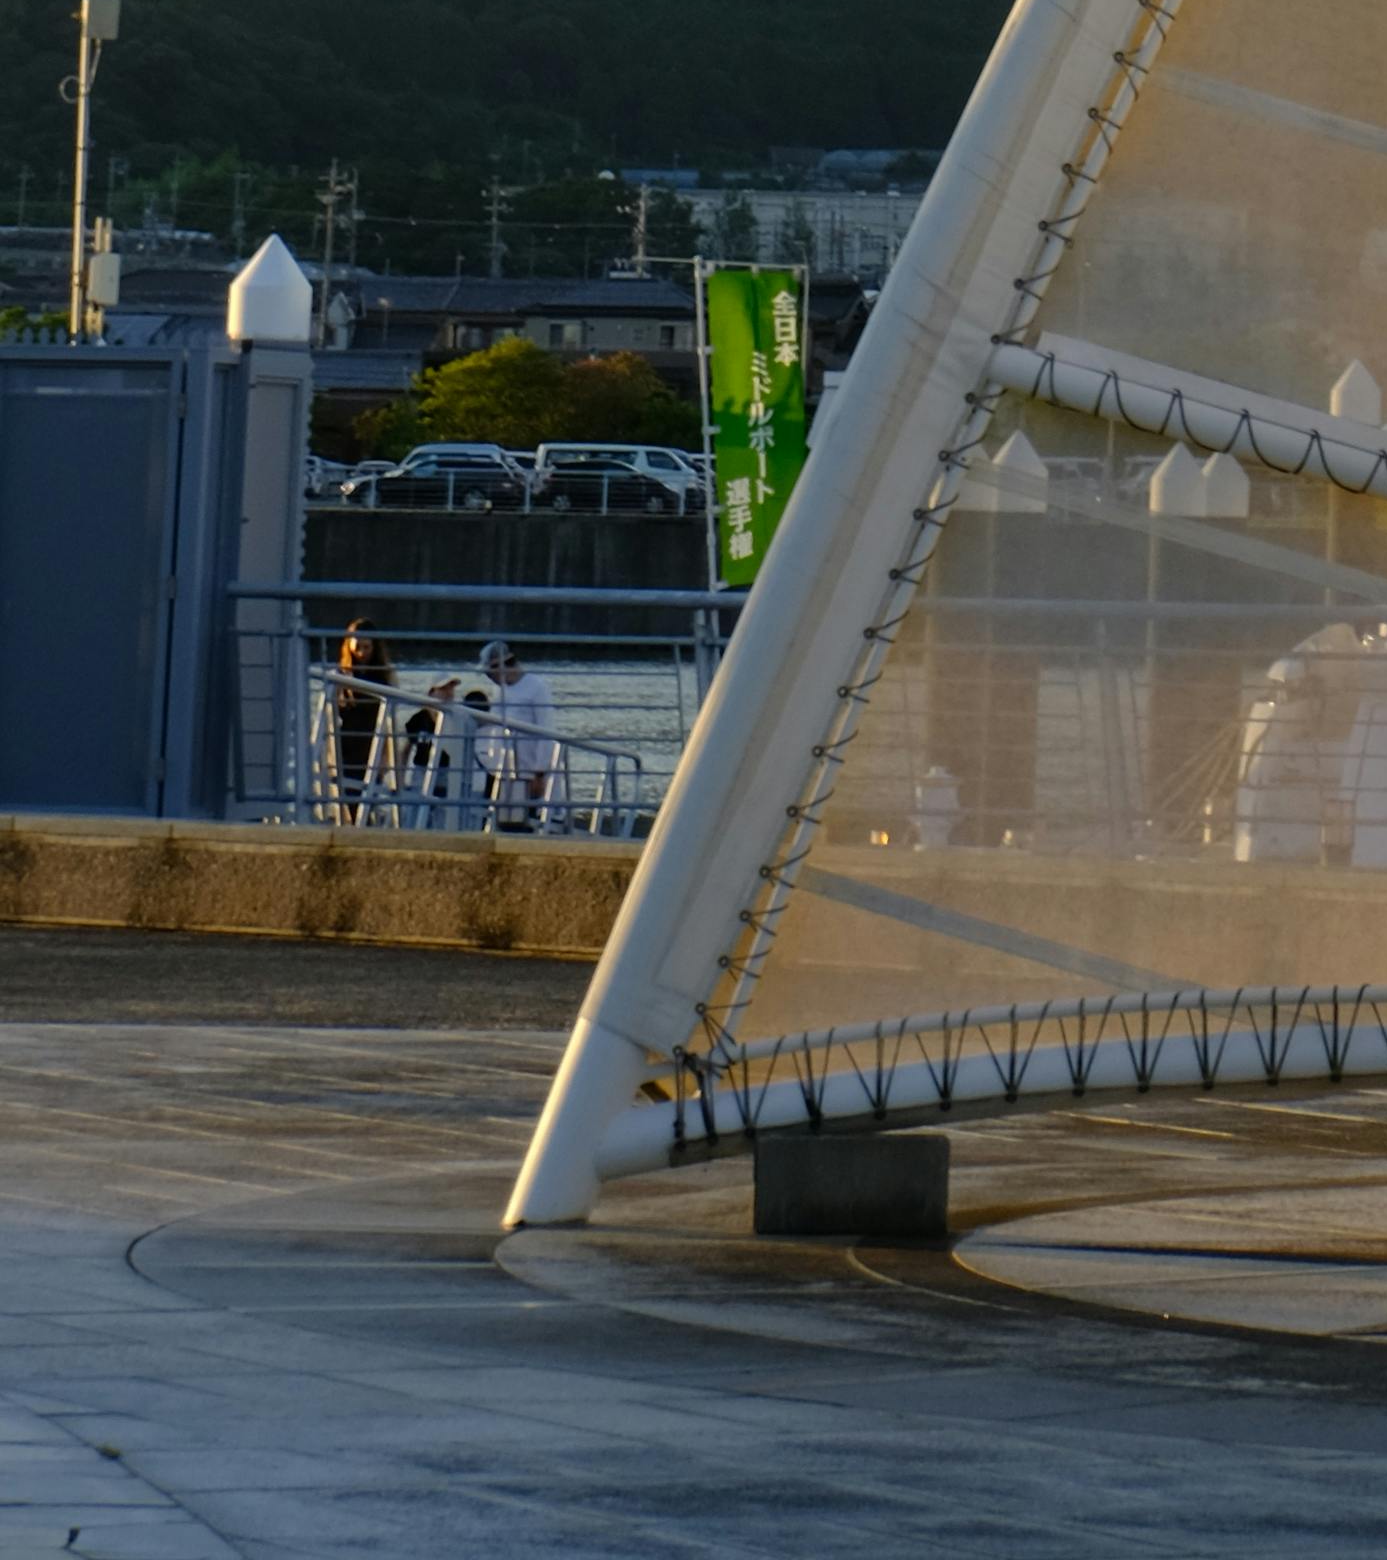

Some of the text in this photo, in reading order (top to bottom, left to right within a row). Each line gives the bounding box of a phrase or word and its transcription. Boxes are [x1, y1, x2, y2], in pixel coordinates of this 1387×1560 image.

[772, 290, 799, 367] 全日本
[748, 351, 775, 504] ミドルボート
[726, 477, 754, 560] 選手権
